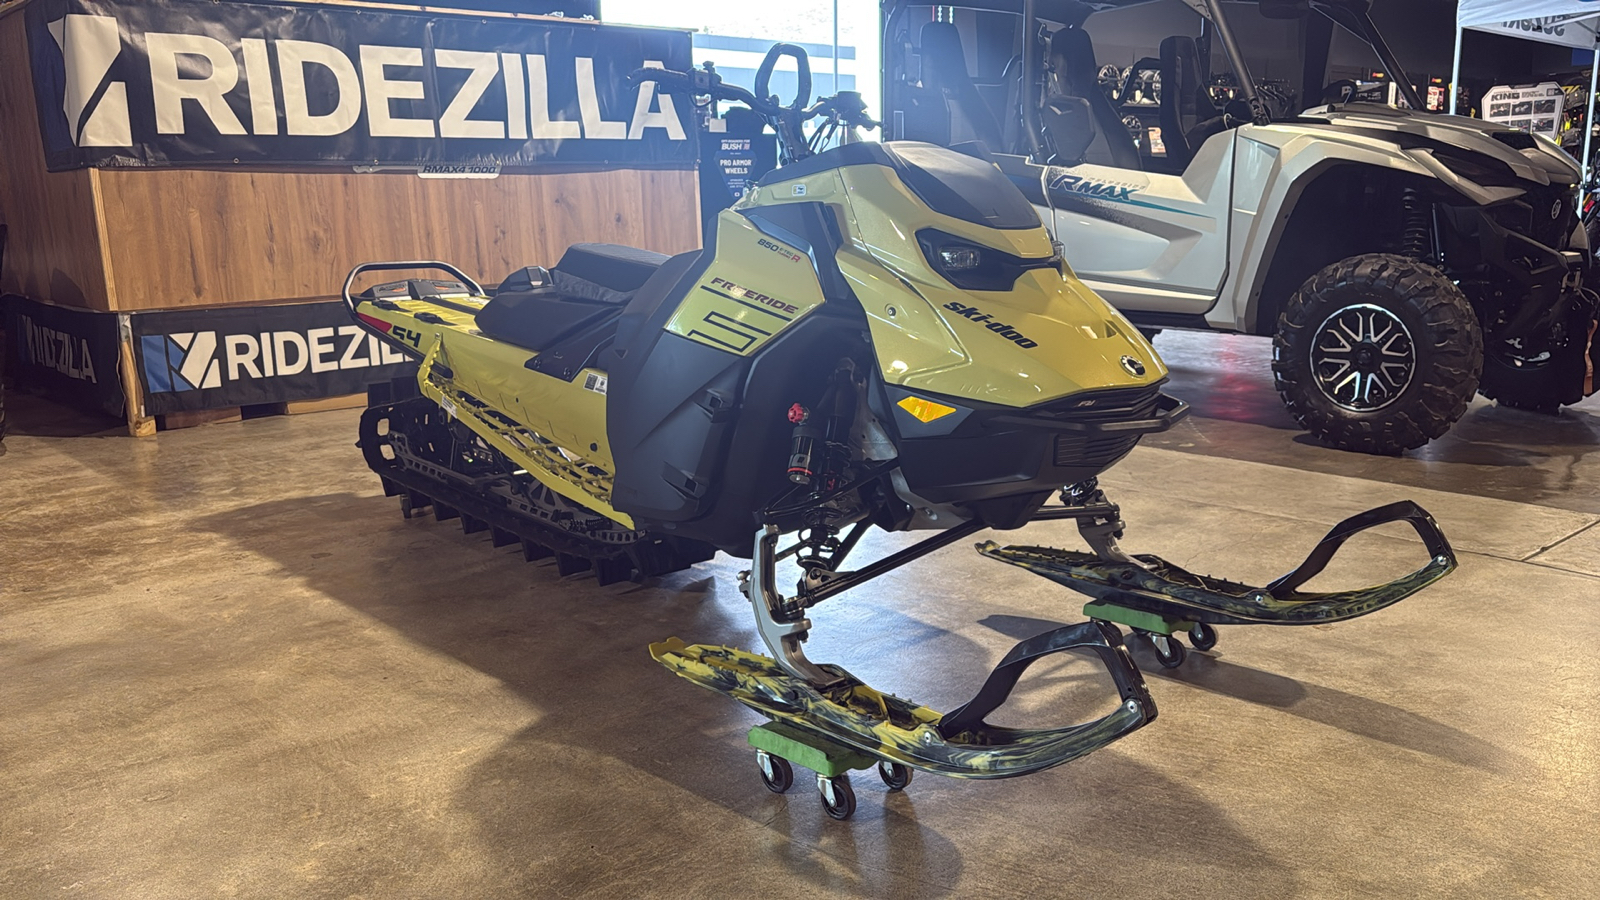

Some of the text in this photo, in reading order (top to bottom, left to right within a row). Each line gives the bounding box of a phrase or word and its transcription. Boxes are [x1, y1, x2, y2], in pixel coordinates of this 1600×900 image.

[145, 32, 687, 141] RIDEZILLA
[1491, 92, 1520, 101] KING
[721, 143, 742, 151] BUSH
[720, 159, 752, 167] PRO ARMOR
[423, 166, 497, 174] RMAX4 1000
[724, 167, 748, 175] WHEELS
[1049, 174, 1139, 201] RMAX
[757, 238, 780, 252] 850
[942, 302, 1038, 349] ski-doo
[225, 325, 415, 380] RIDEZIL
